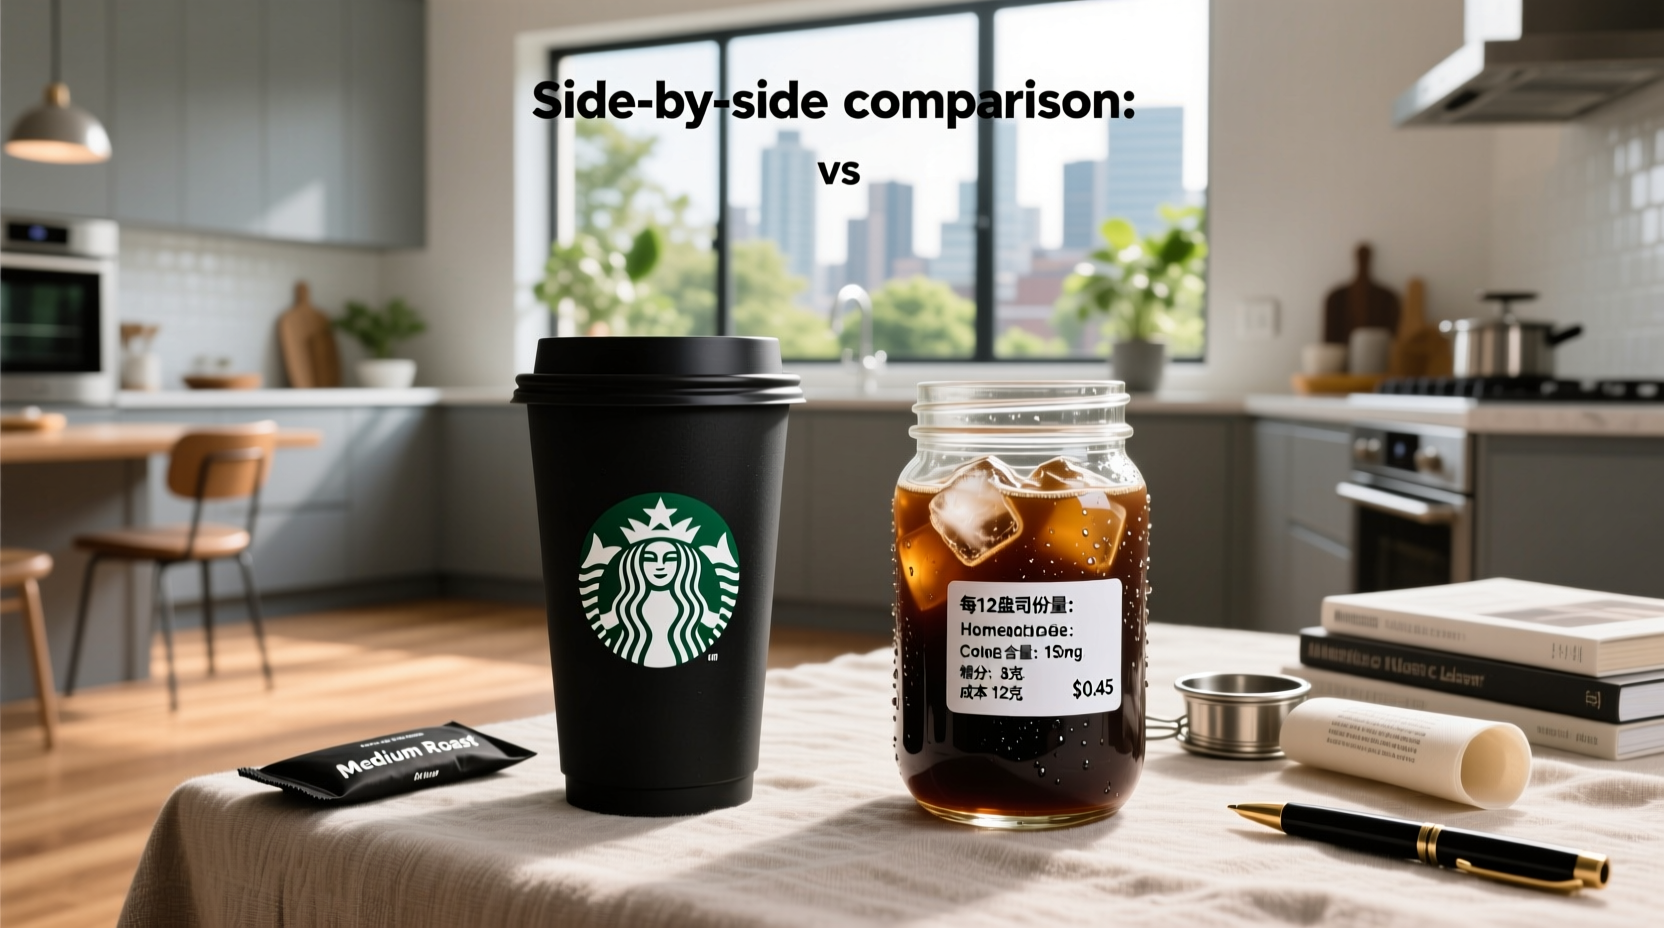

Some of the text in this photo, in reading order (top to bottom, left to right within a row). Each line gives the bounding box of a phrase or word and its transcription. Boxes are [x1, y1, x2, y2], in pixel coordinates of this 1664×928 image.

[1072, 679, 1114, 700] $0.45
[336, 745, 424, 779] Medium
[421, 733, 480, 755] Roast
